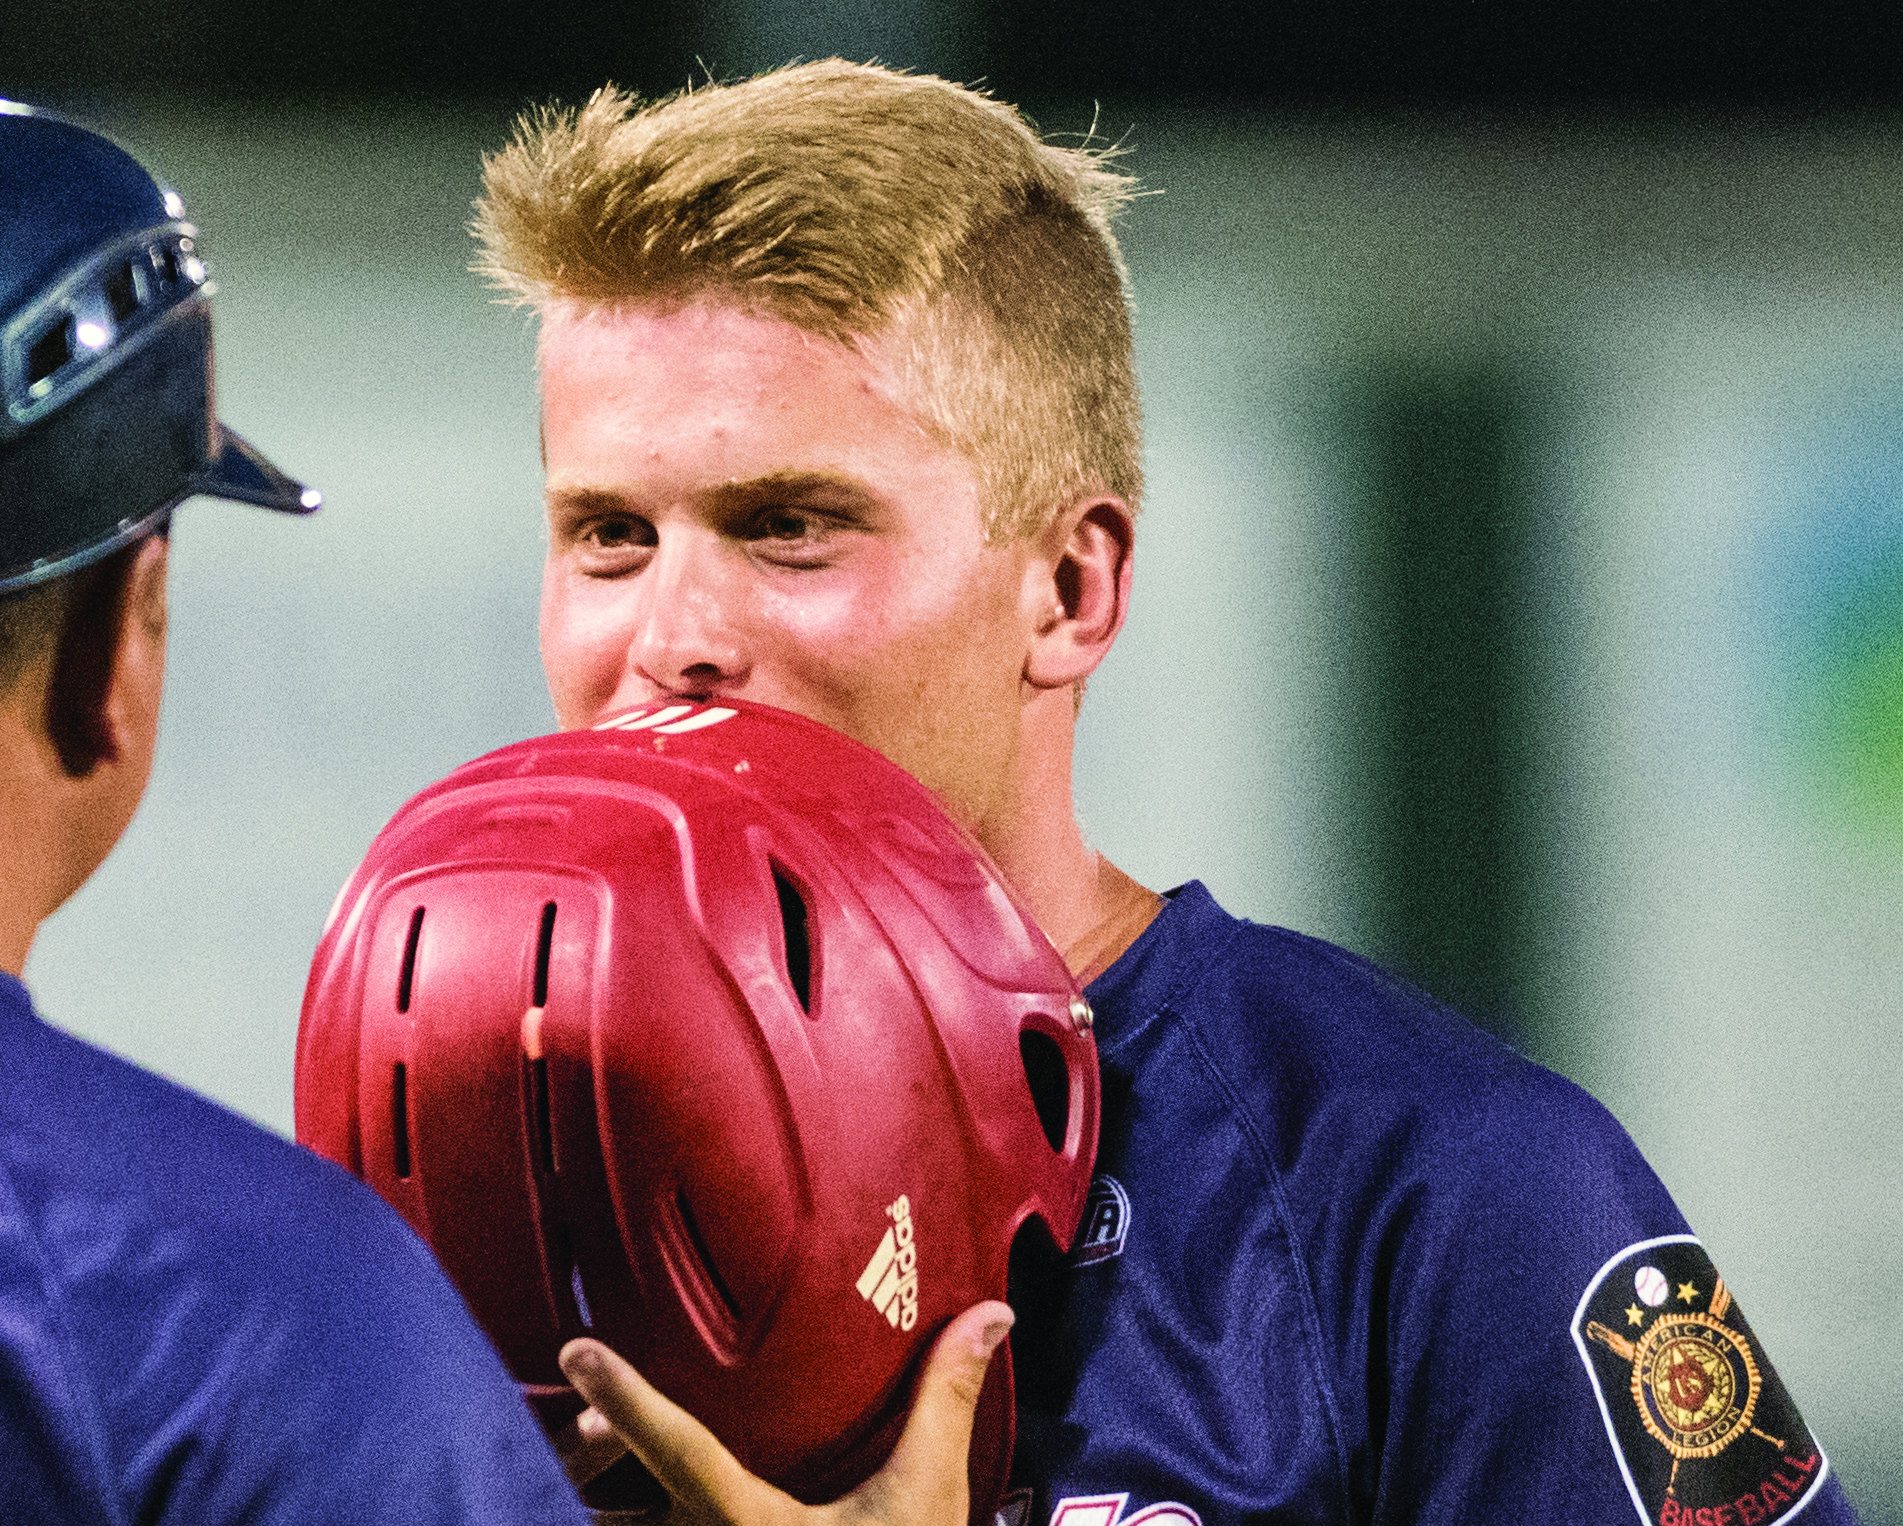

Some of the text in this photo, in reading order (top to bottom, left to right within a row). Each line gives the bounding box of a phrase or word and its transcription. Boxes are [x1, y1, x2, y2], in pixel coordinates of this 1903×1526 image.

[892, 1194, 919, 1333] adidas
[1641, 1323, 1734, 1386] AMERICAN
[1671, 1405, 1742, 1448] LEGION
